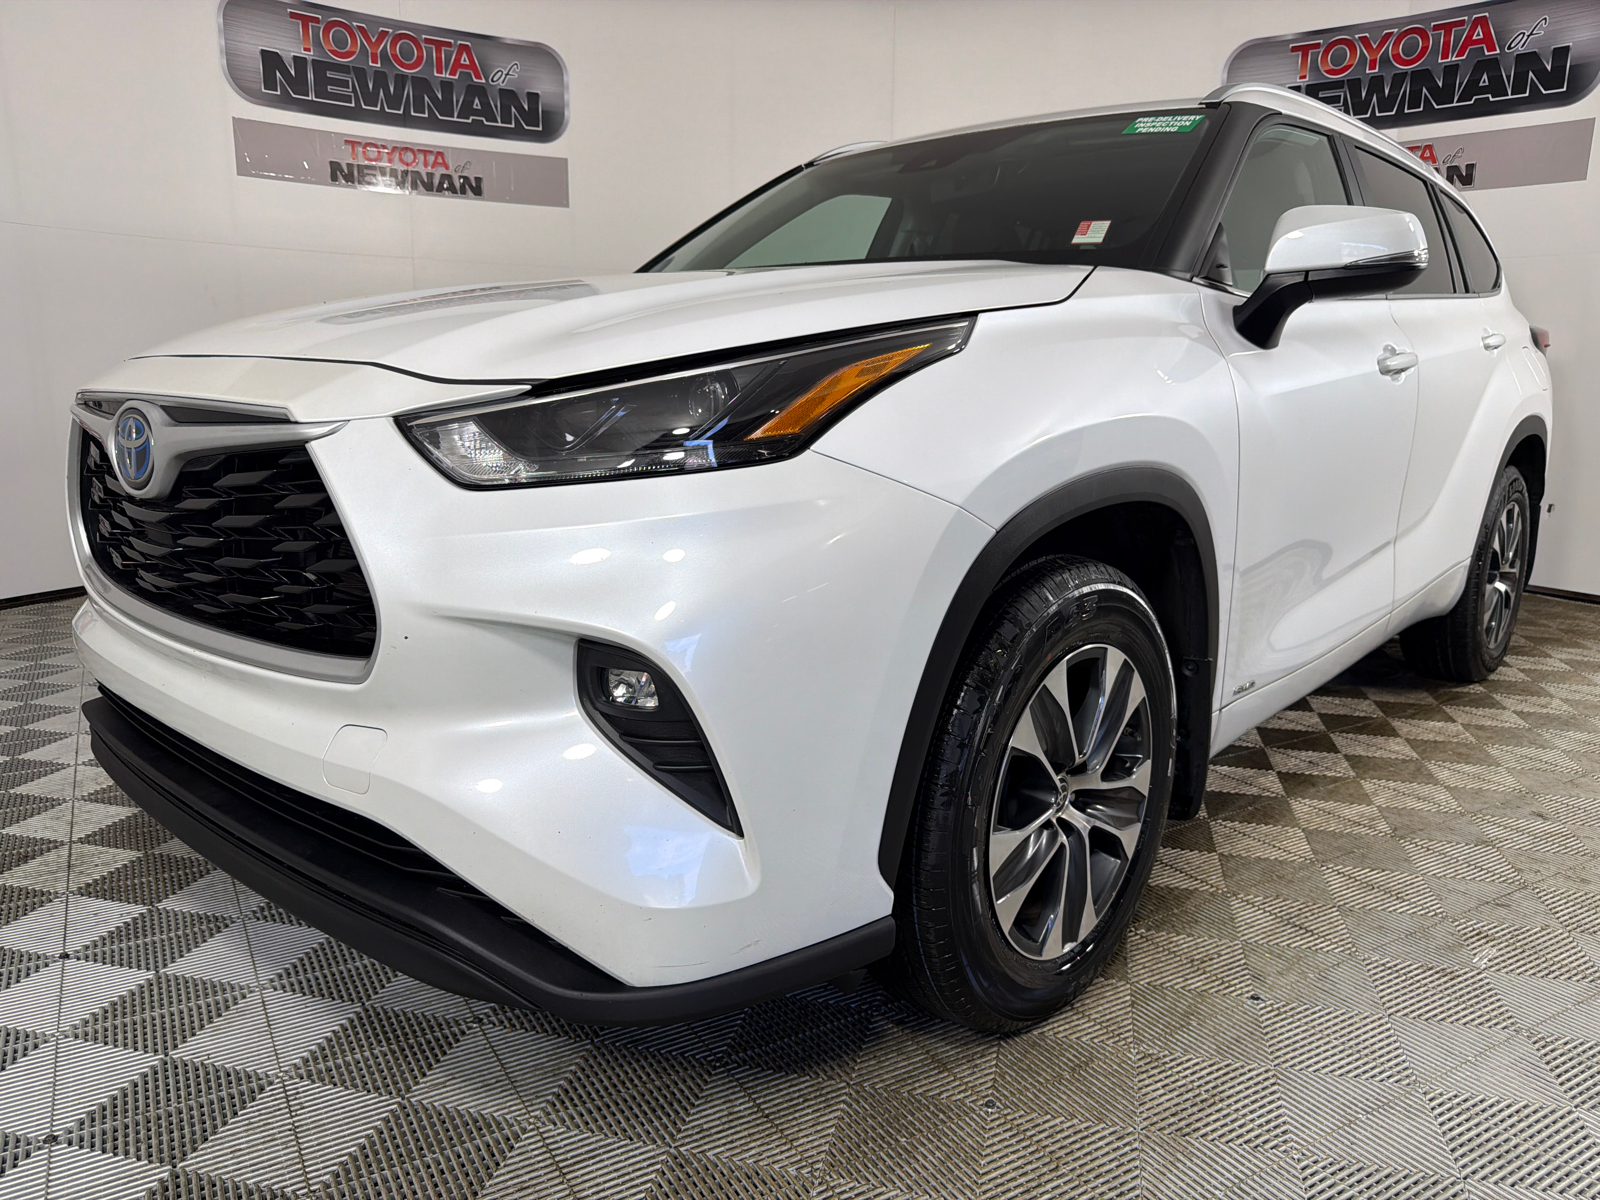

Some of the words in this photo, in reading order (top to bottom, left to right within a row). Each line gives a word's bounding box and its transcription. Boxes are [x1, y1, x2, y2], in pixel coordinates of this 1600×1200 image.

[288, 10, 484, 82] TOYOTA
[490, 62, 520, 86] of
[1290, 13, 1499, 81] TOYOTA
[1506, 16, 1548, 51] of
[259, 48, 542, 130] NEWNAN
[1135, 115, 1203, 123] PRE-DELIVERY
[344, 139, 450, 171] TOYOTA
[455, 161, 473, 174] of
[1442, 146, 1464, 165] of
[329, 160, 483, 197] NEWNAN
